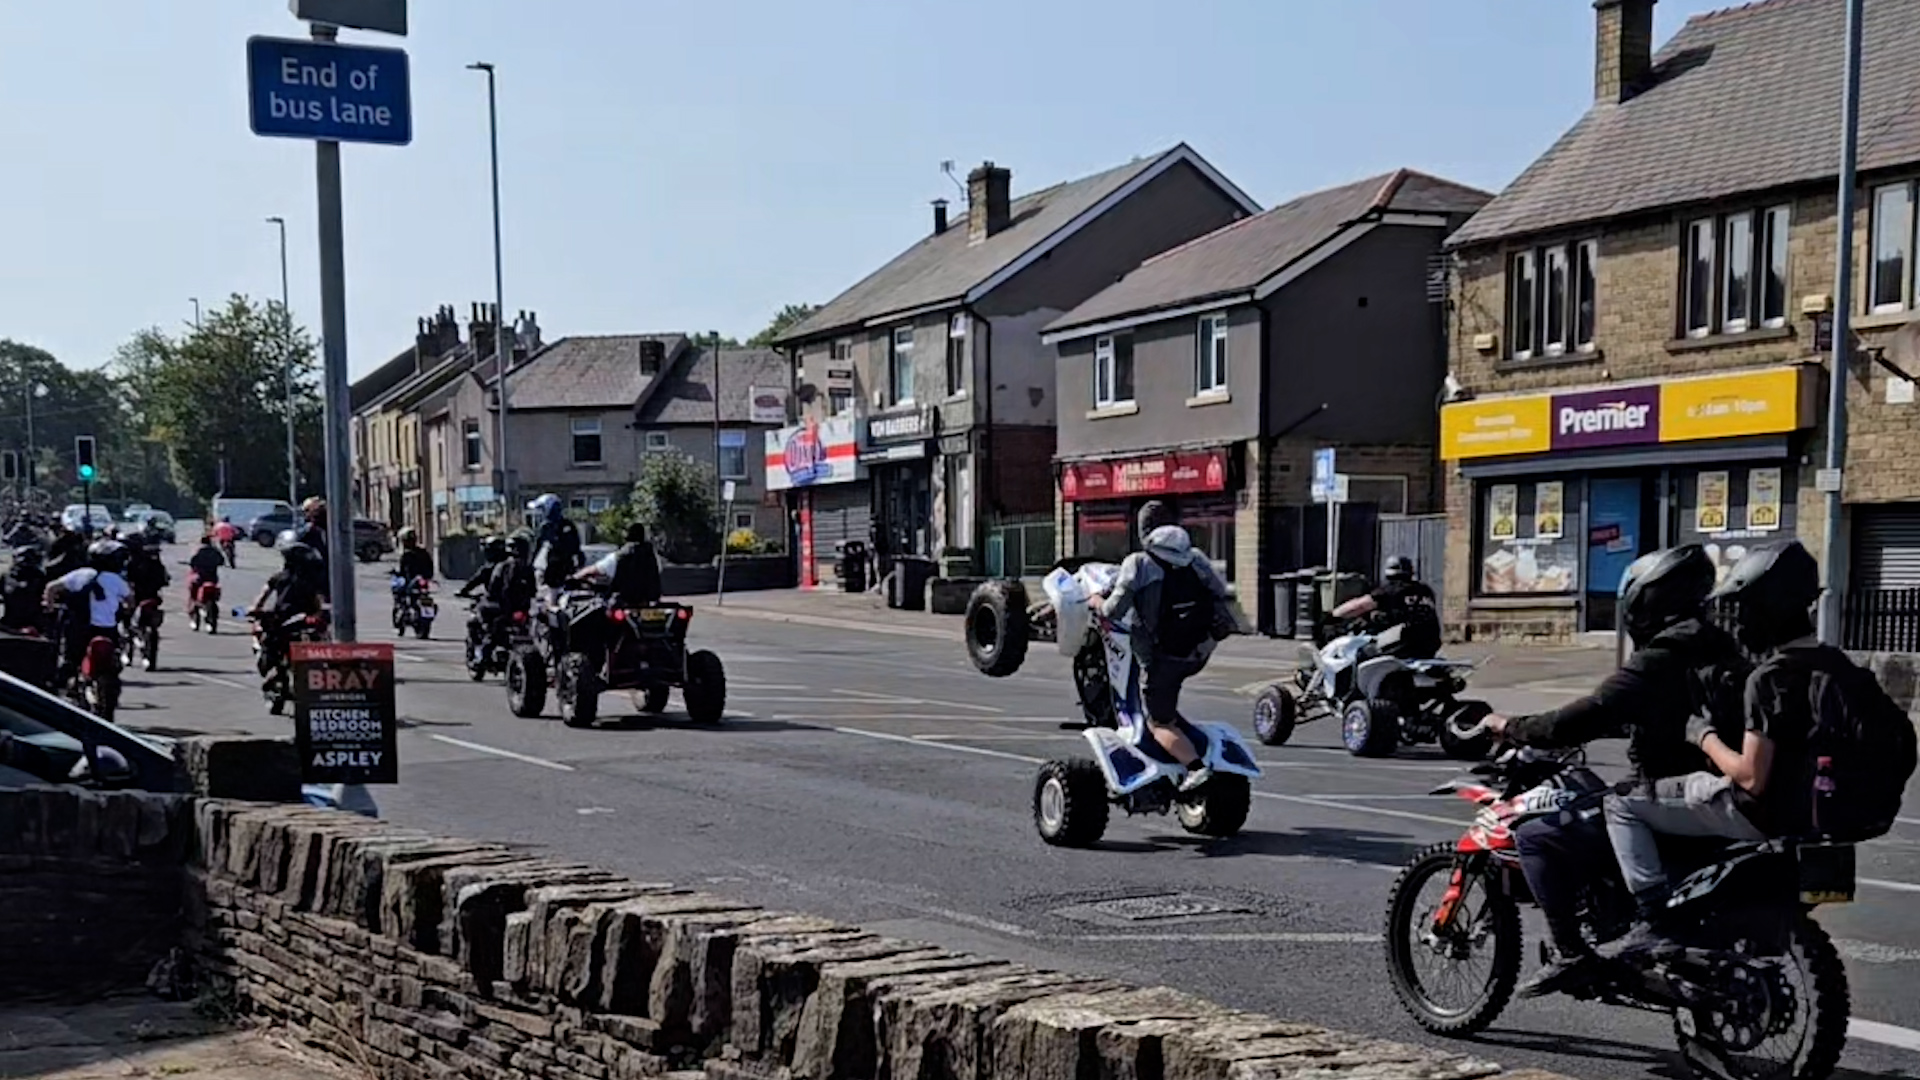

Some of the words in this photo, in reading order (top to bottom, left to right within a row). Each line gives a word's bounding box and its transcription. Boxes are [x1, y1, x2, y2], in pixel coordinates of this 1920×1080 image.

[281, 56, 338, 88] End
[350, 64, 379, 91] of
[269, 91, 323, 121] bus
[330, 96, 392, 126] lane
[1560, 401, 1650, 435] Premier
[308, 669, 379, 690] BRAY
[309, 709, 370, 720] KITCHEN
[310, 720, 382, 731] BEDROOM
[310, 731, 382, 741] SHOWROOM
[312, 751, 382, 767] ASPLEY
